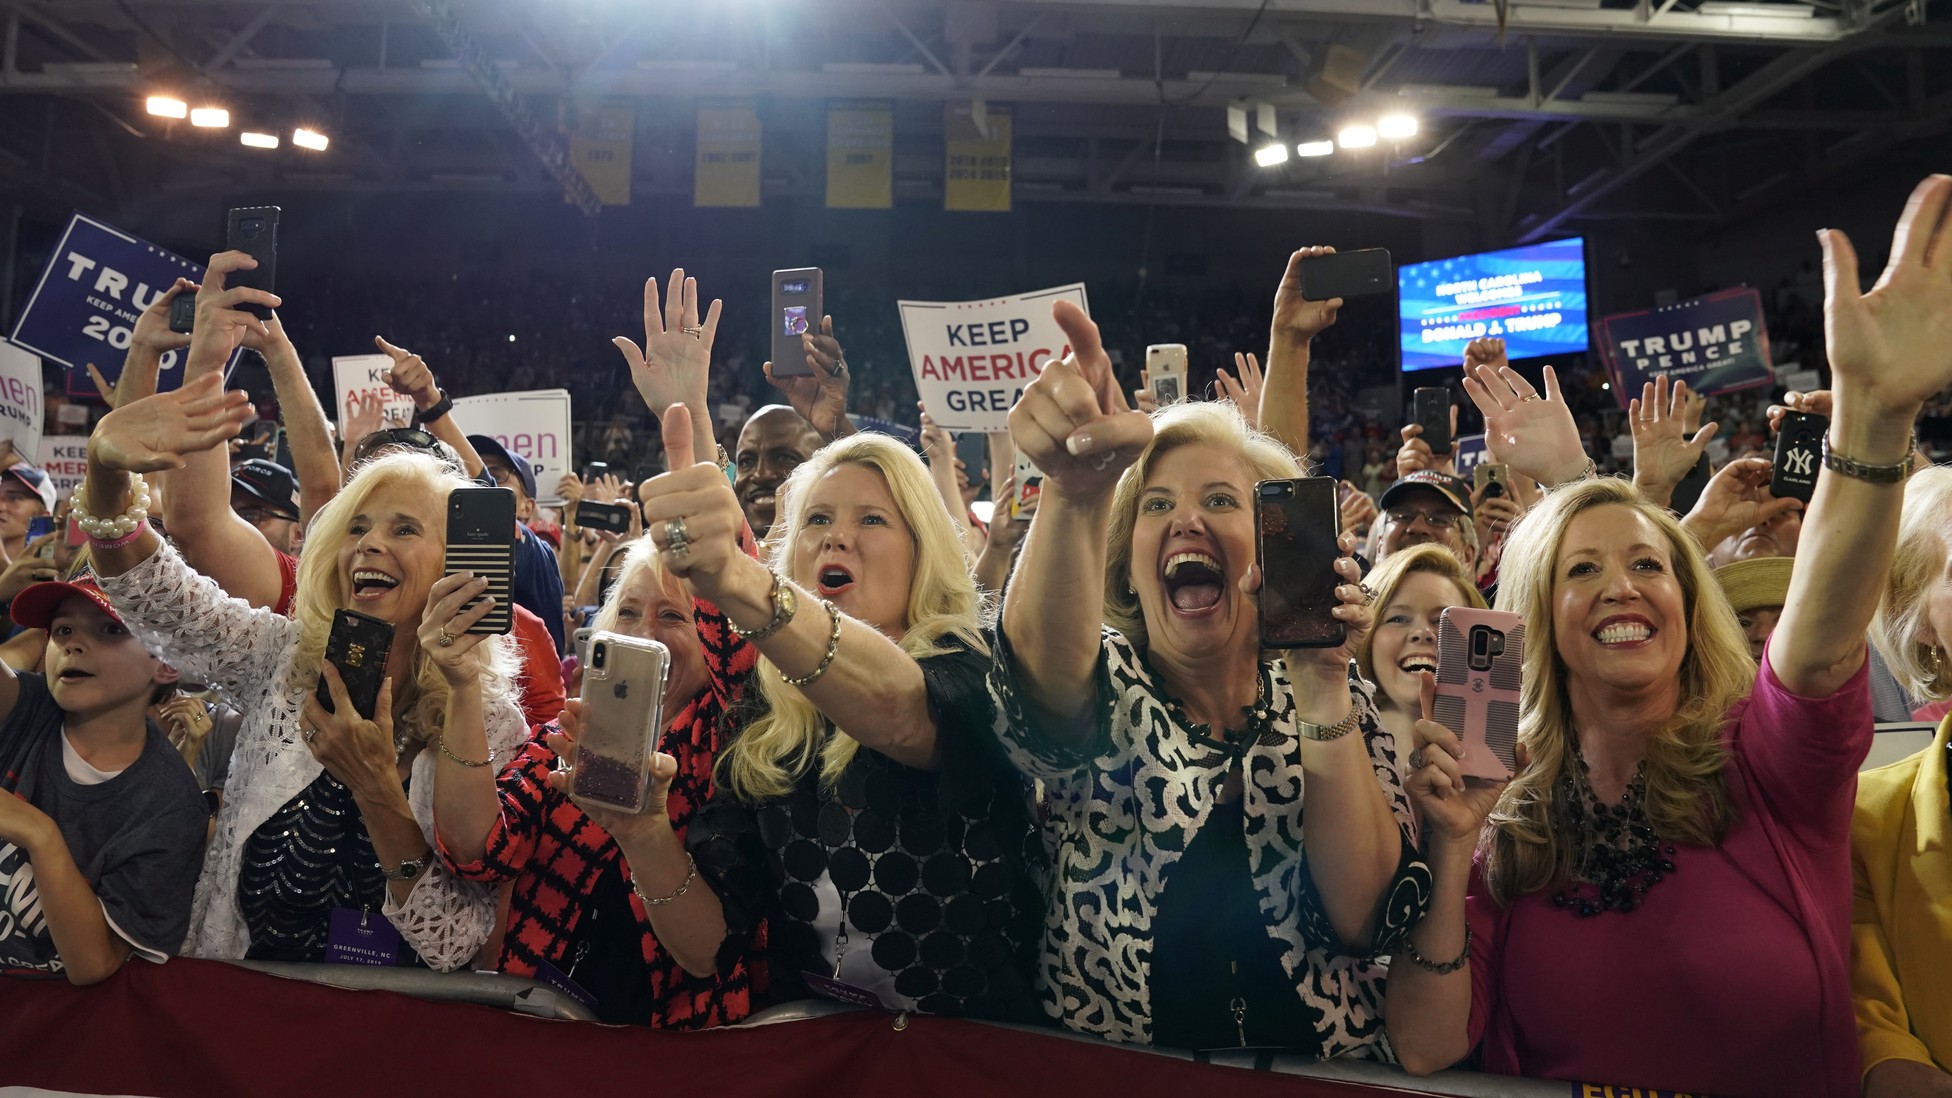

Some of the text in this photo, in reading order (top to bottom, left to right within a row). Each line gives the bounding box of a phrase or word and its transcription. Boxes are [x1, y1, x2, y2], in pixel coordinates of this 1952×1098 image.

[1436, 270, 1543, 297] NORTH CAROLINA
[86, 295, 114, 311] KEEP
[946, 318, 1029, 347] KEEP
[1421, 322, 1486, 343] DONALD
[1504, 312, 1562, 333] TRUMP
[1620, 319, 1752, 358] TRUMP
[1636, 341, 1743, 370] PENCE
[1669, 364, 1705, 376] AMERICA
[0, 376, 37, 416] en
[1783, 447, 1814, 476] NY
[333, 944, 378, 957] GREENVILLE,
